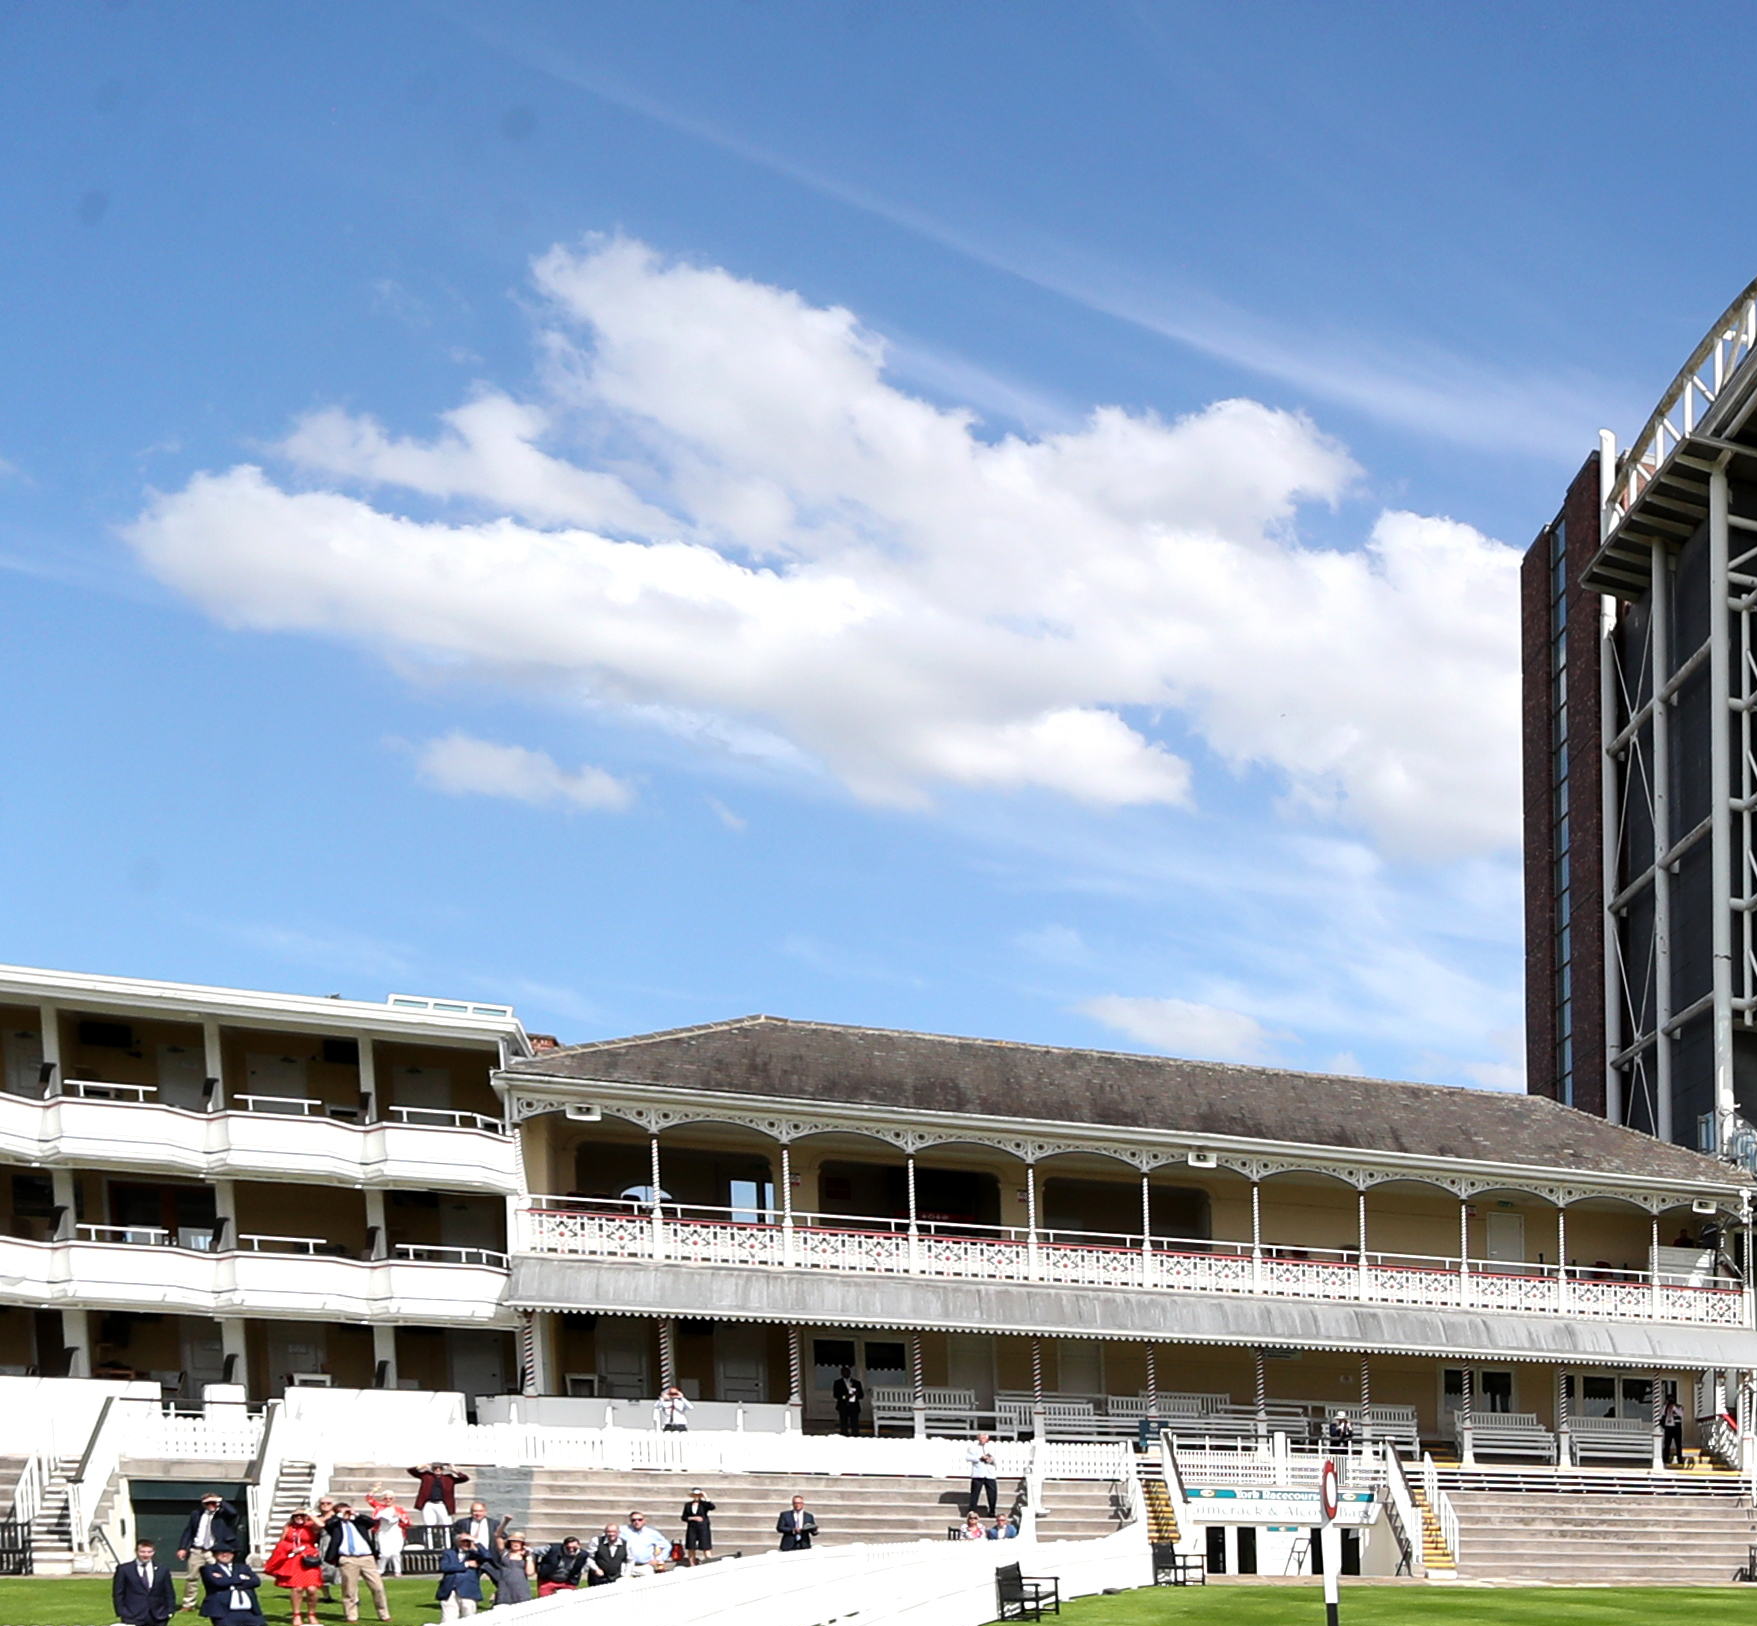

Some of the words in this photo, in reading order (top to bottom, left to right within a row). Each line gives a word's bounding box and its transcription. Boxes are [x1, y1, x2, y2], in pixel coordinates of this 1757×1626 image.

[1235, 1490, 1260, 1500] York
[1262, 1490, 1321, 1502] Racecours
[1285, 1506, 1321, 1517] Alco
